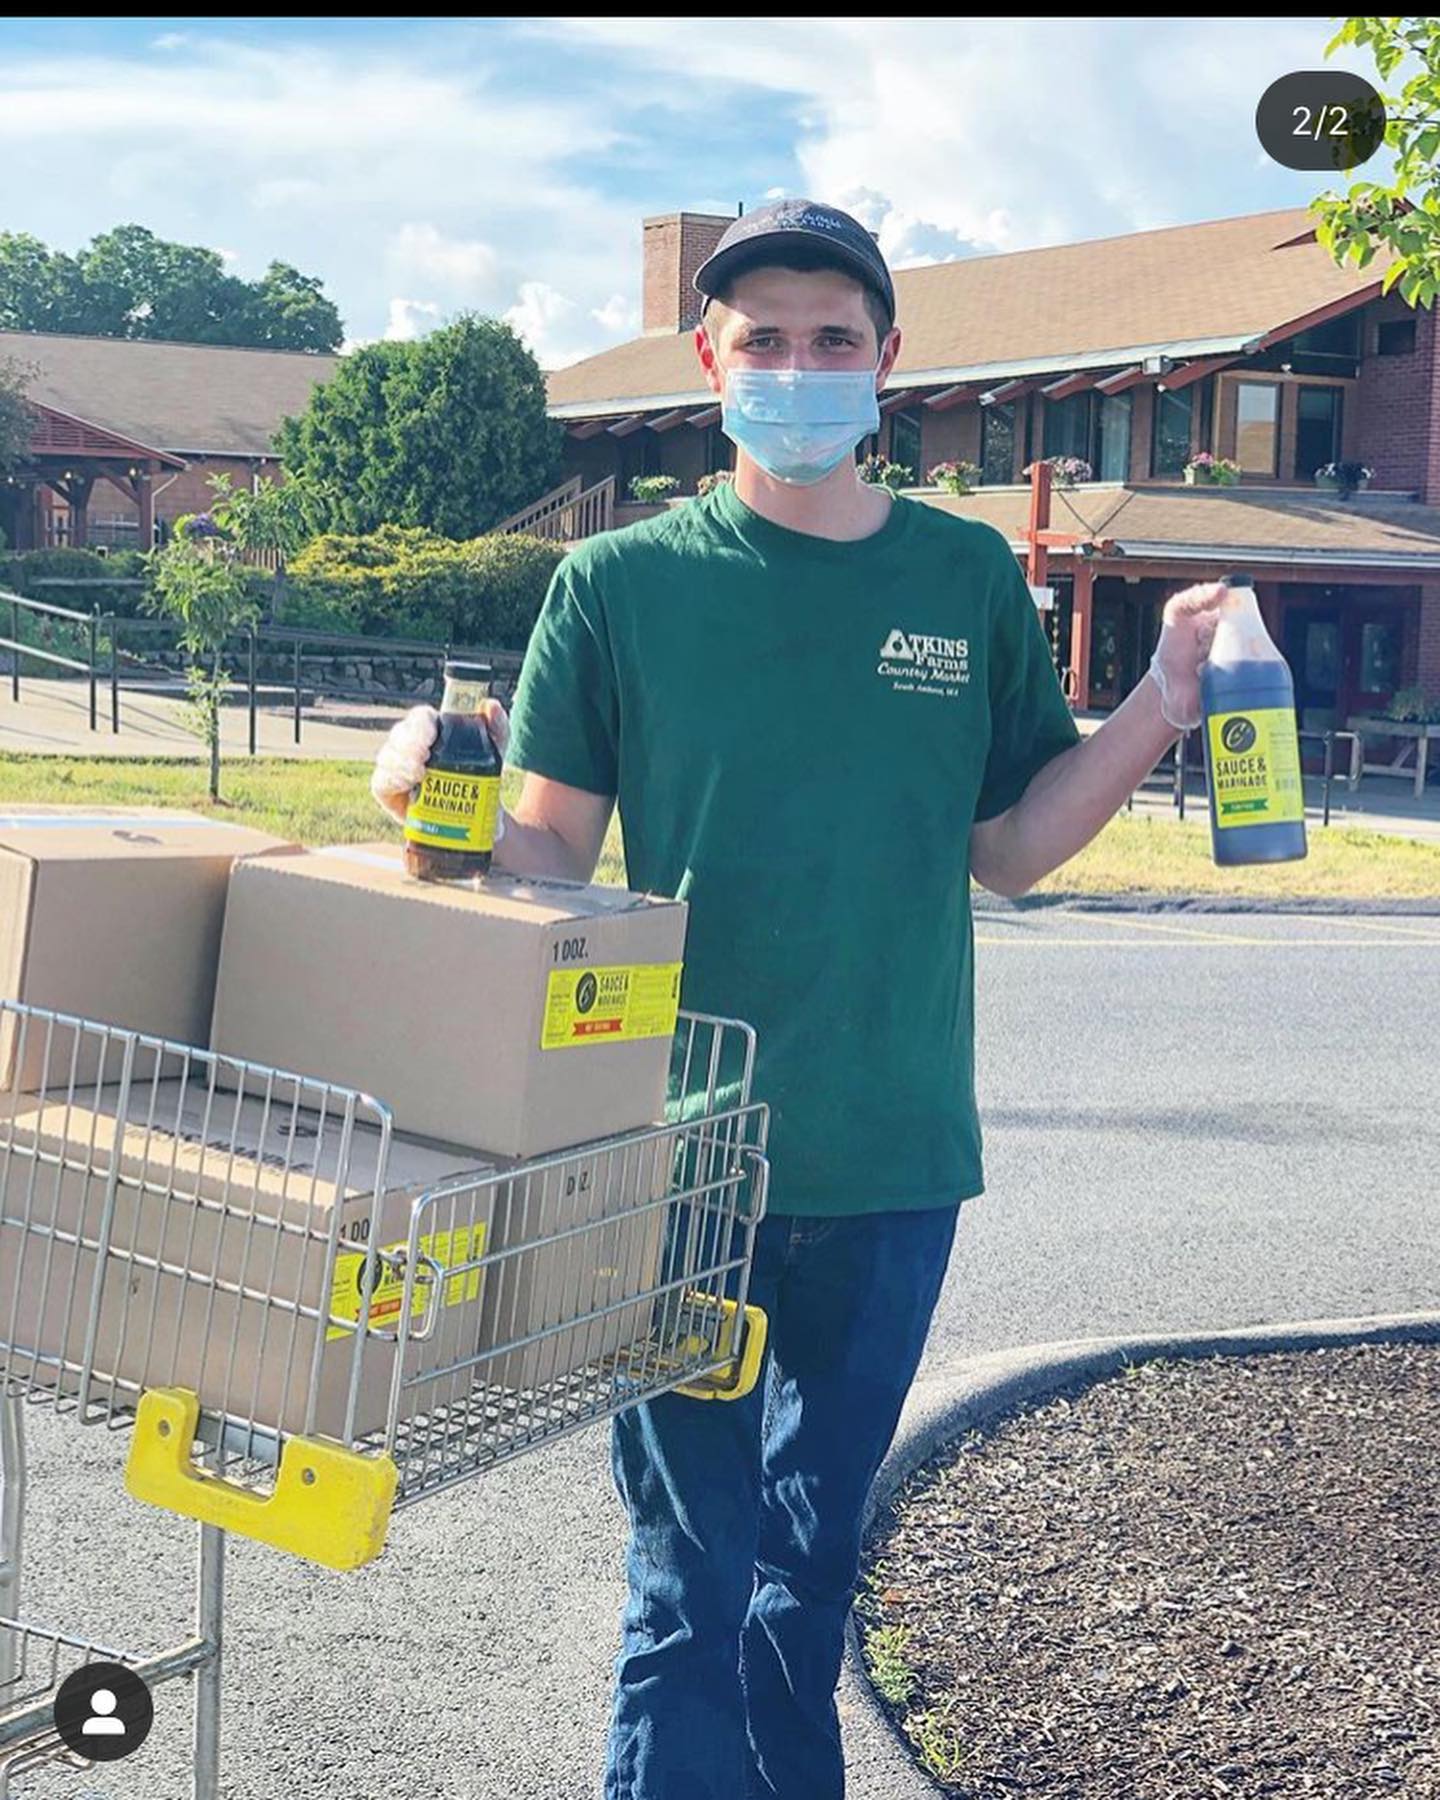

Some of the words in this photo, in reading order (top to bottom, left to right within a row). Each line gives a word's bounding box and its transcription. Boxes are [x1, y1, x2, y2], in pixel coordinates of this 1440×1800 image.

[880, 629, 968, 658] ATKINS
[877, 661, 928, 681] Country
[916, 653, 968, 671] Farms
[1216, 758, 1256, 778] SAUCE
[425, 777, 469, 799] SAUCE
[423, 794, 477, 816] MARINADE
